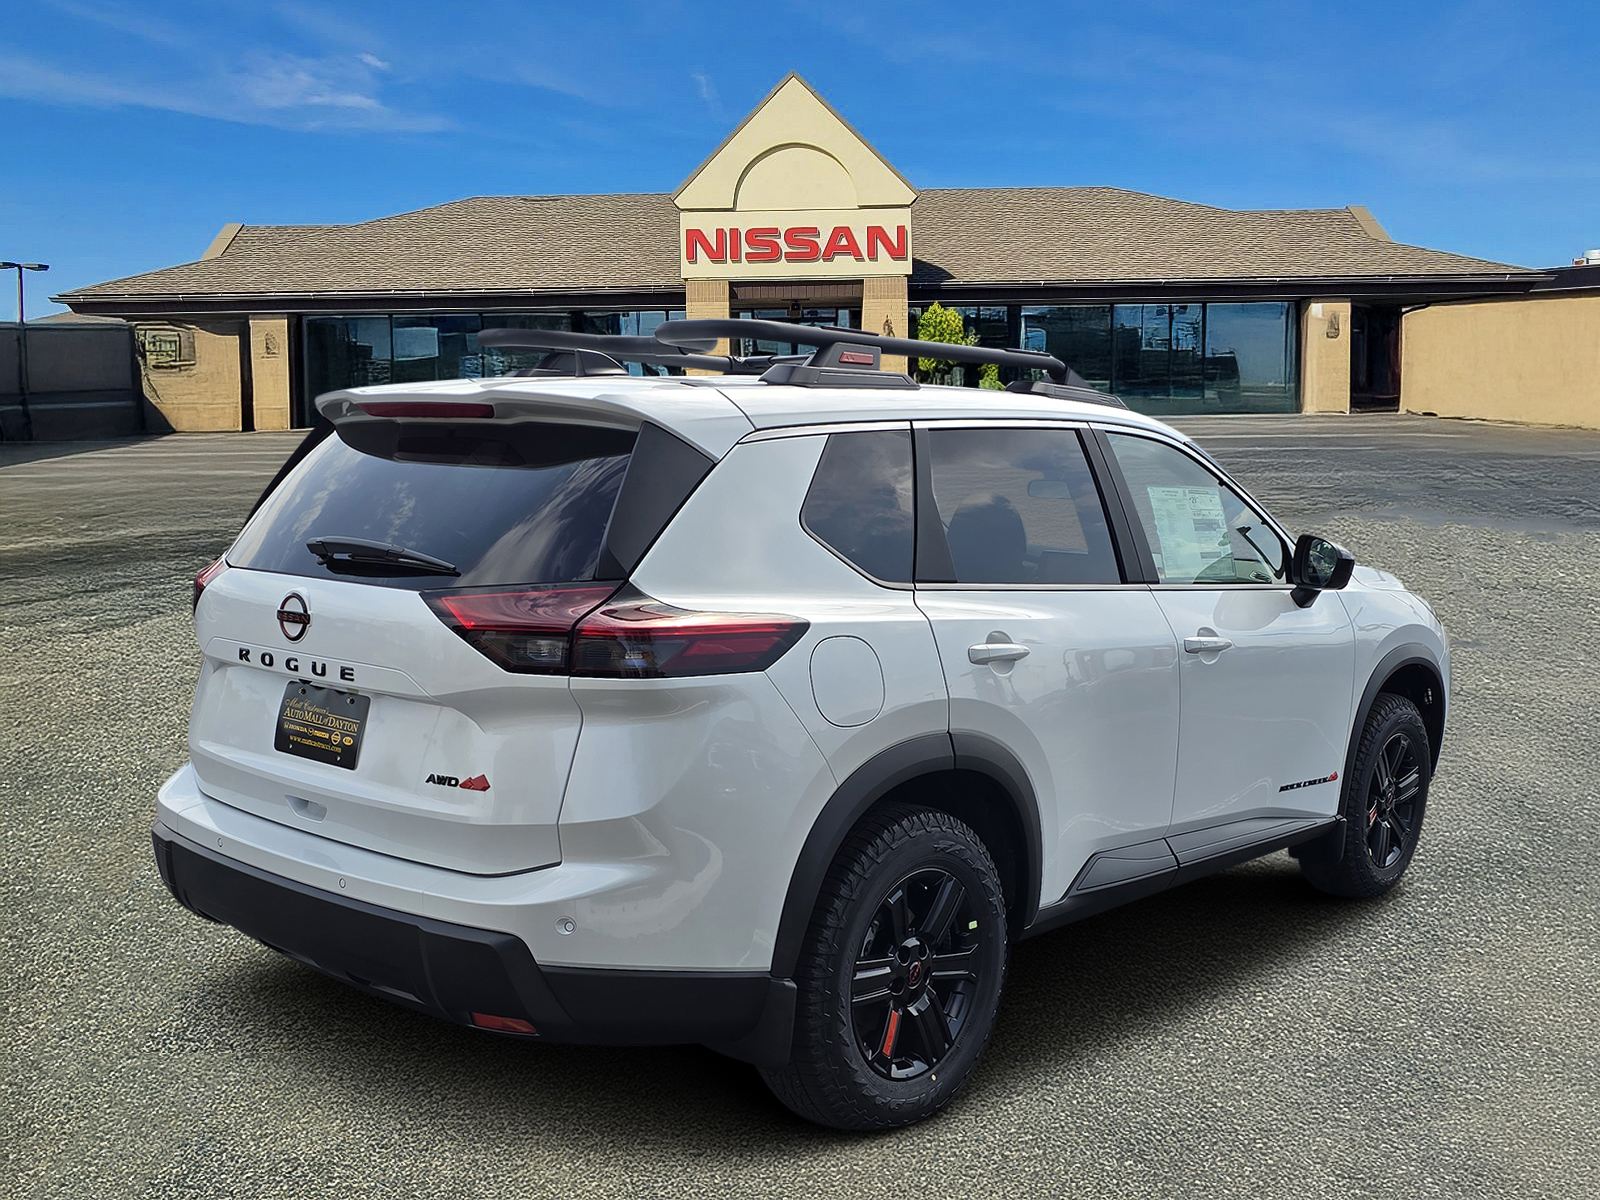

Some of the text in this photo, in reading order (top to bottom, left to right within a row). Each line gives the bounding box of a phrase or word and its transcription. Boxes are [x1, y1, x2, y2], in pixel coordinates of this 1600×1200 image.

[685, 225, 908, 264] NISSAN
[238, 647, 355, 682] ROGUE
[288, 723, 308, 733] HONDA
[328, 716, 359, 732] DAYTON
[425, 773, 460, 787] AWD
